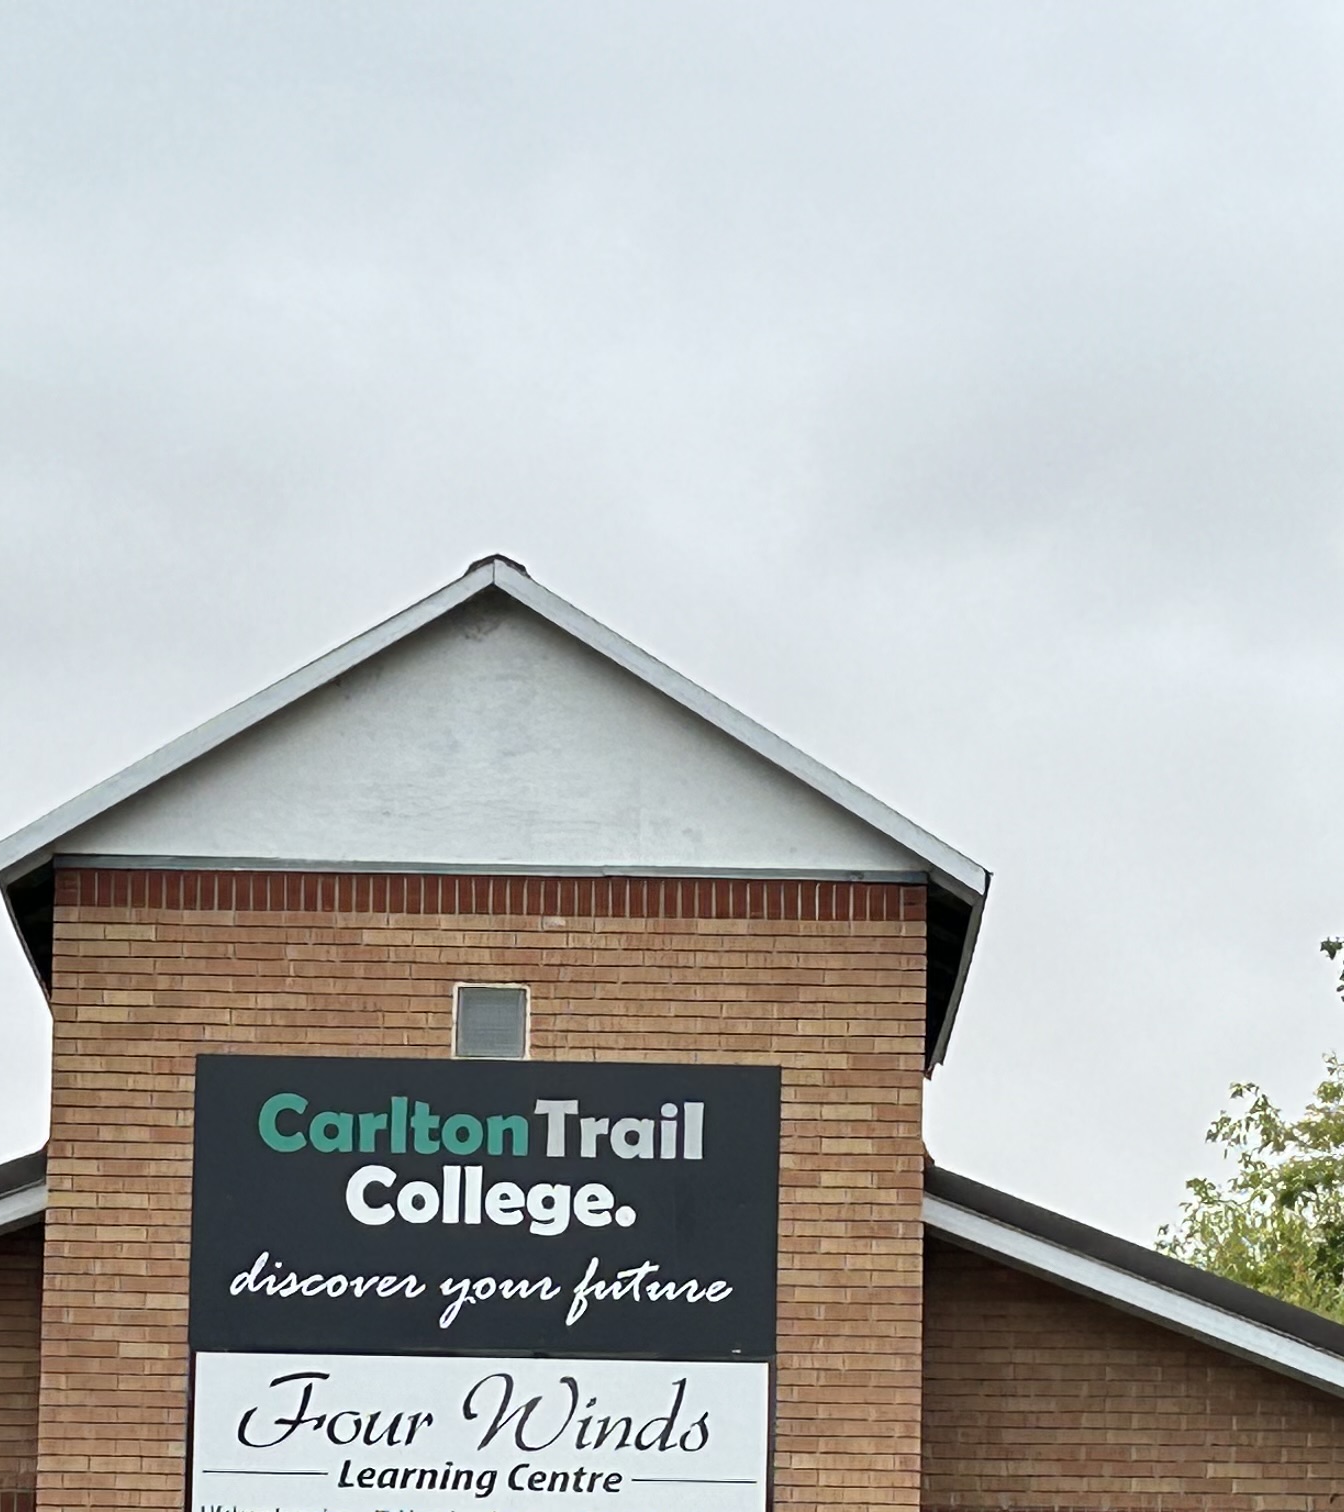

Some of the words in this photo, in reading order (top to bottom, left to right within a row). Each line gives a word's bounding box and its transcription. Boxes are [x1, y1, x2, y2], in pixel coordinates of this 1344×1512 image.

[259, 1093, 528, 1156] Carlton
[534, 1099, 704, 1159] Trail
[346, 1165, 636, 1236] College.
[229, 1251, 426, 1298] discover
[439, 1276, 561, 1329] your
[566, 1256, 734, 1327] future
[237, 1371, 434, 1449] Four
[462, 1372, 710, 1452] Winds
[337, 1459, 498, 1498] Learning
[507, 1463, 623, 1493] Centre
